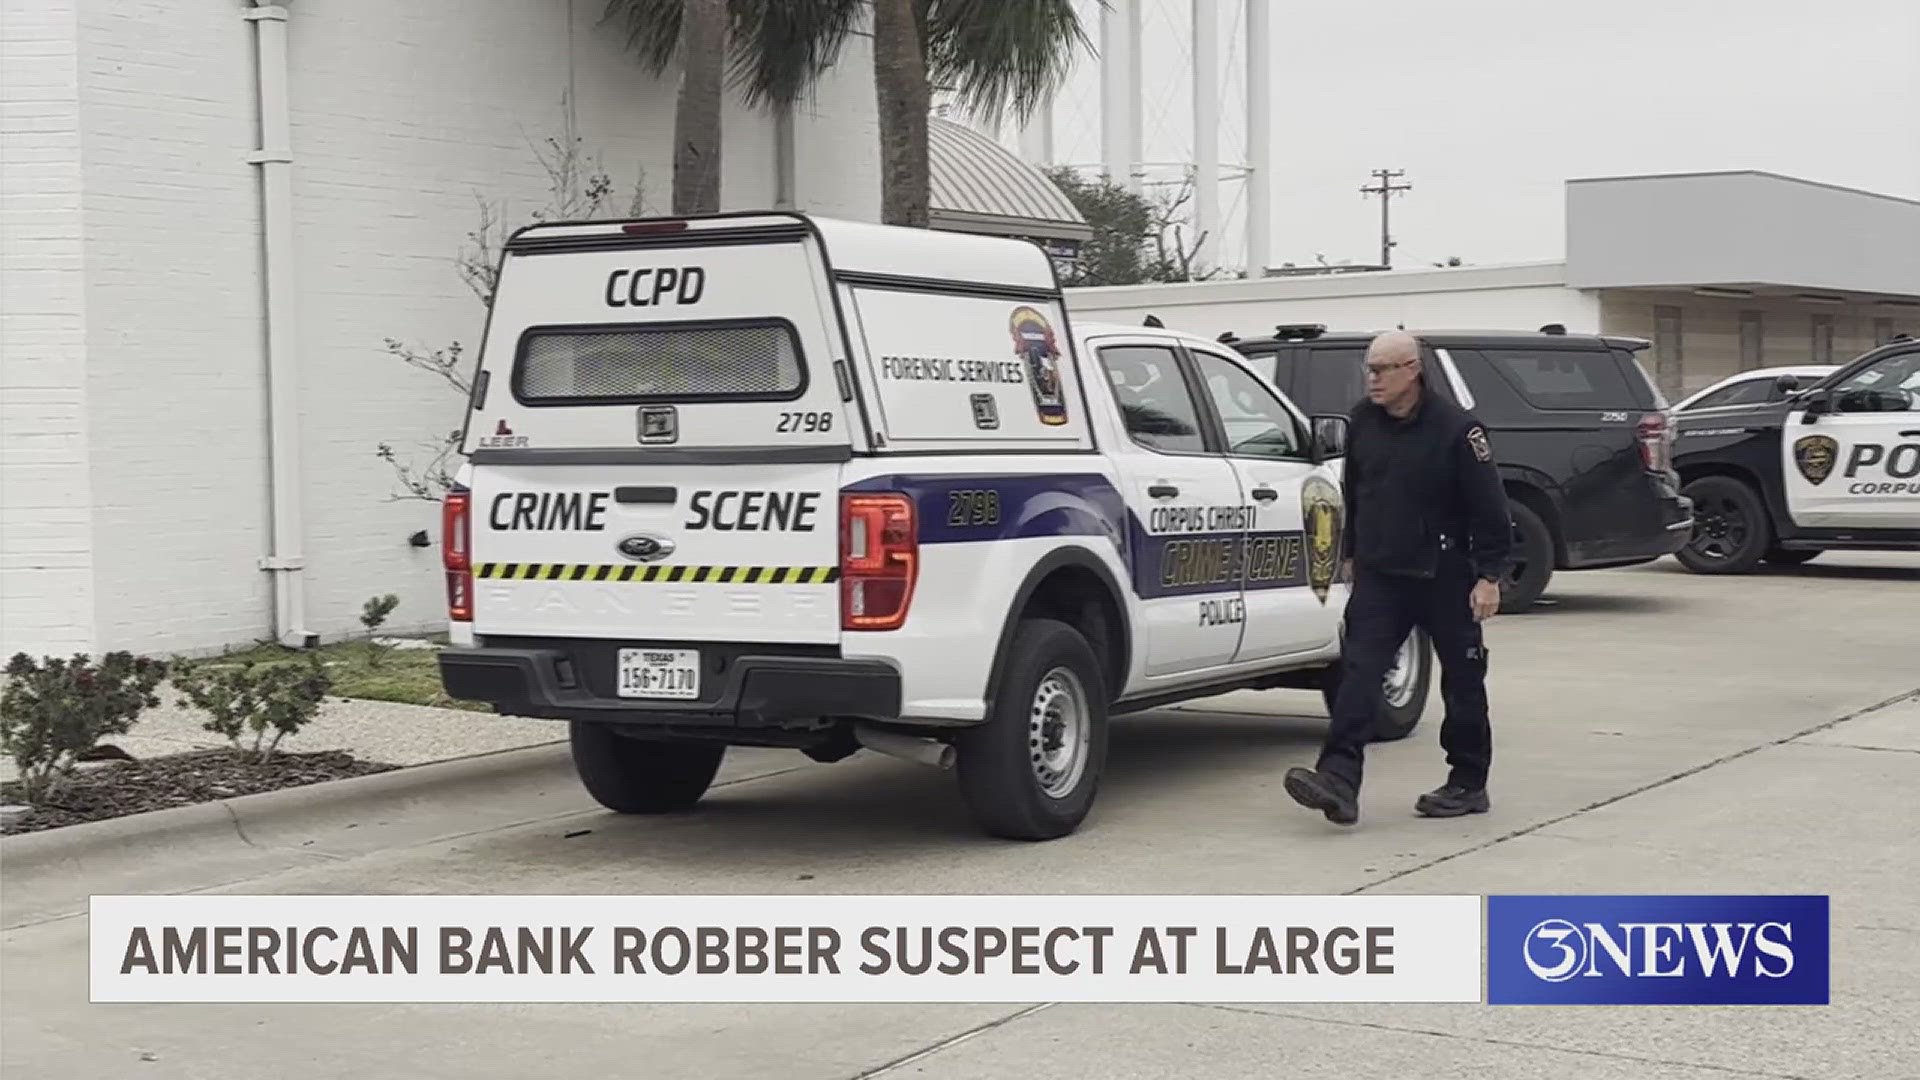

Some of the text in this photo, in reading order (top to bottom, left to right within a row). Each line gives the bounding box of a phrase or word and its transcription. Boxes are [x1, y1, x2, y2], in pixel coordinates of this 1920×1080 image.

[605, 267, 705, 307] CCPD
[882, 357, 1024, 384] FORENSIC SERVICES
[776, 412, 833, 433] 2798
[479, 436, 530, 448] LEER
[490, 491, 821, 532] CRIME SCENE
[947, 489, 1000, 526] 2798
[1150, 505, 1257, 533] CORPUS CHRISTI
[1161, 535, 1302, 588] CRIME SCENE
[1198, 598, 1245, 627] POLICE
